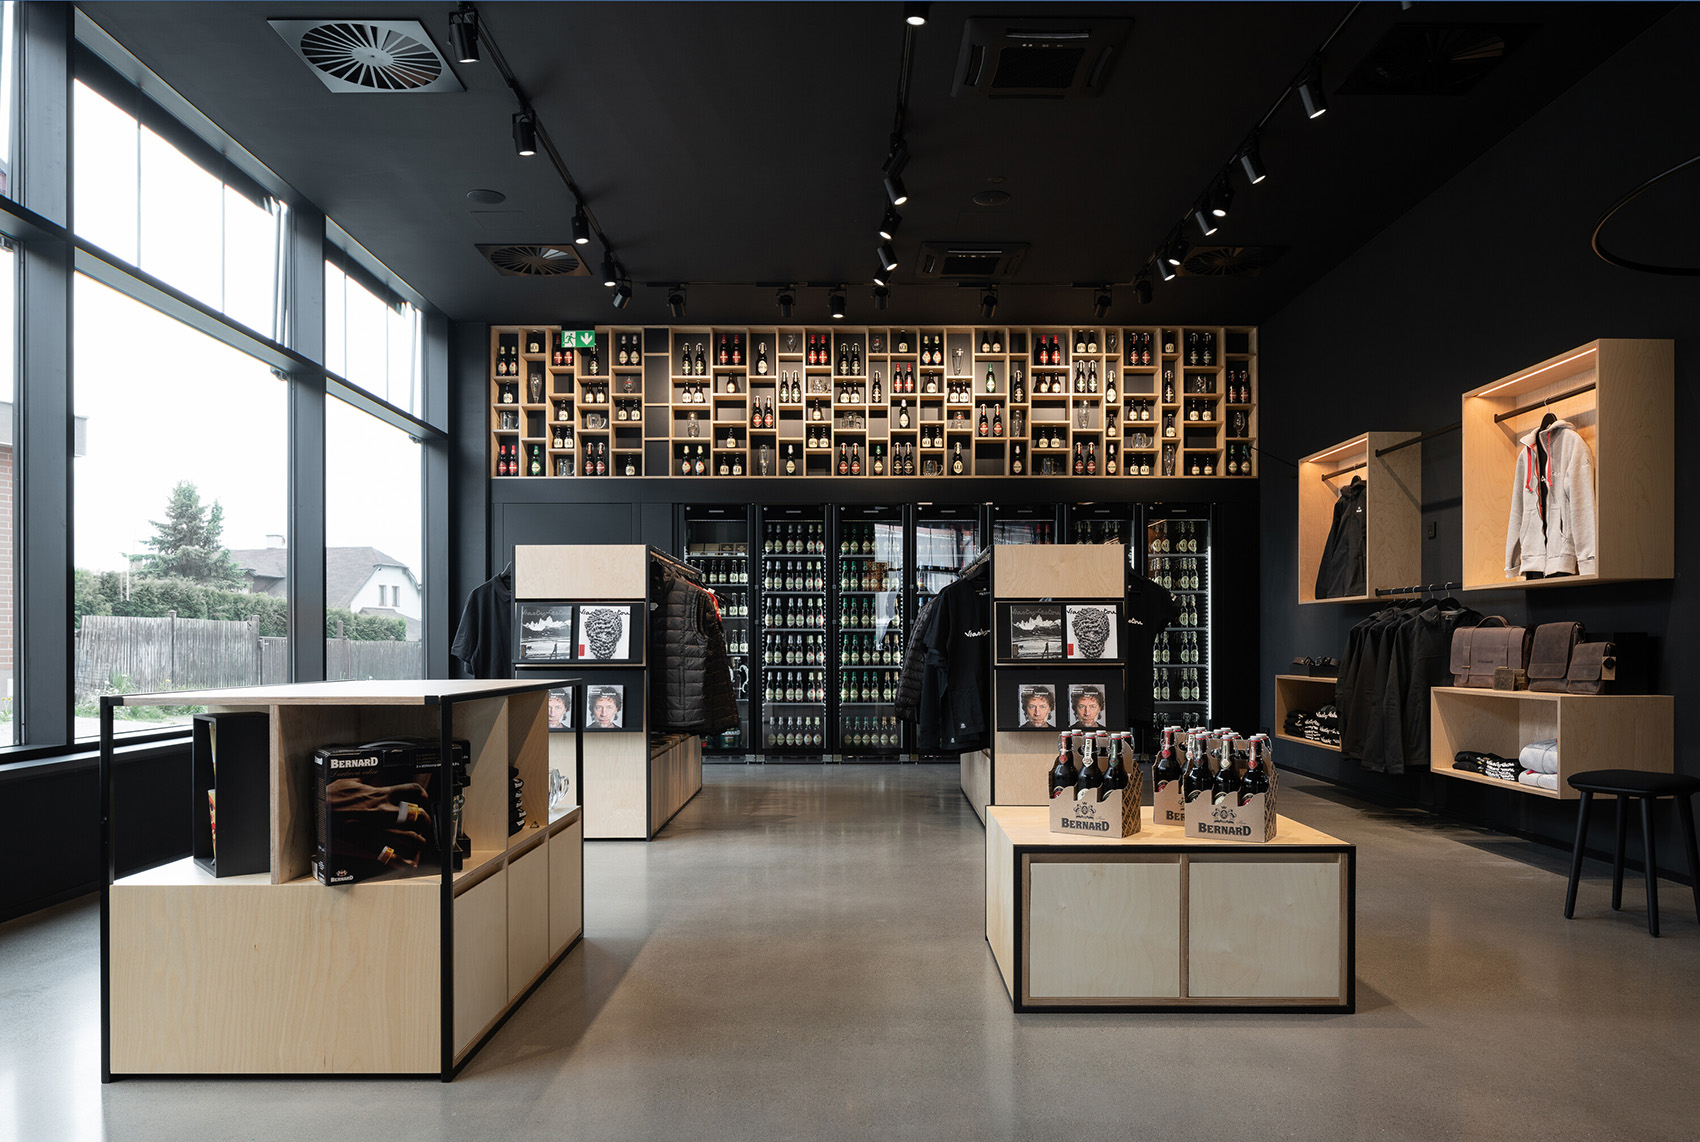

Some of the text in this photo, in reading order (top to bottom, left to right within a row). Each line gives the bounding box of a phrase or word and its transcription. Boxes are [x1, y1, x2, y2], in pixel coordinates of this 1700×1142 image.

[330, 757, 378, 769] BERNARD
[1061, 817, 1110, 832] BERNARD
[1198, 822, 1252, 836] BERNARD
[330, 875, 354, 883] BERNARD
